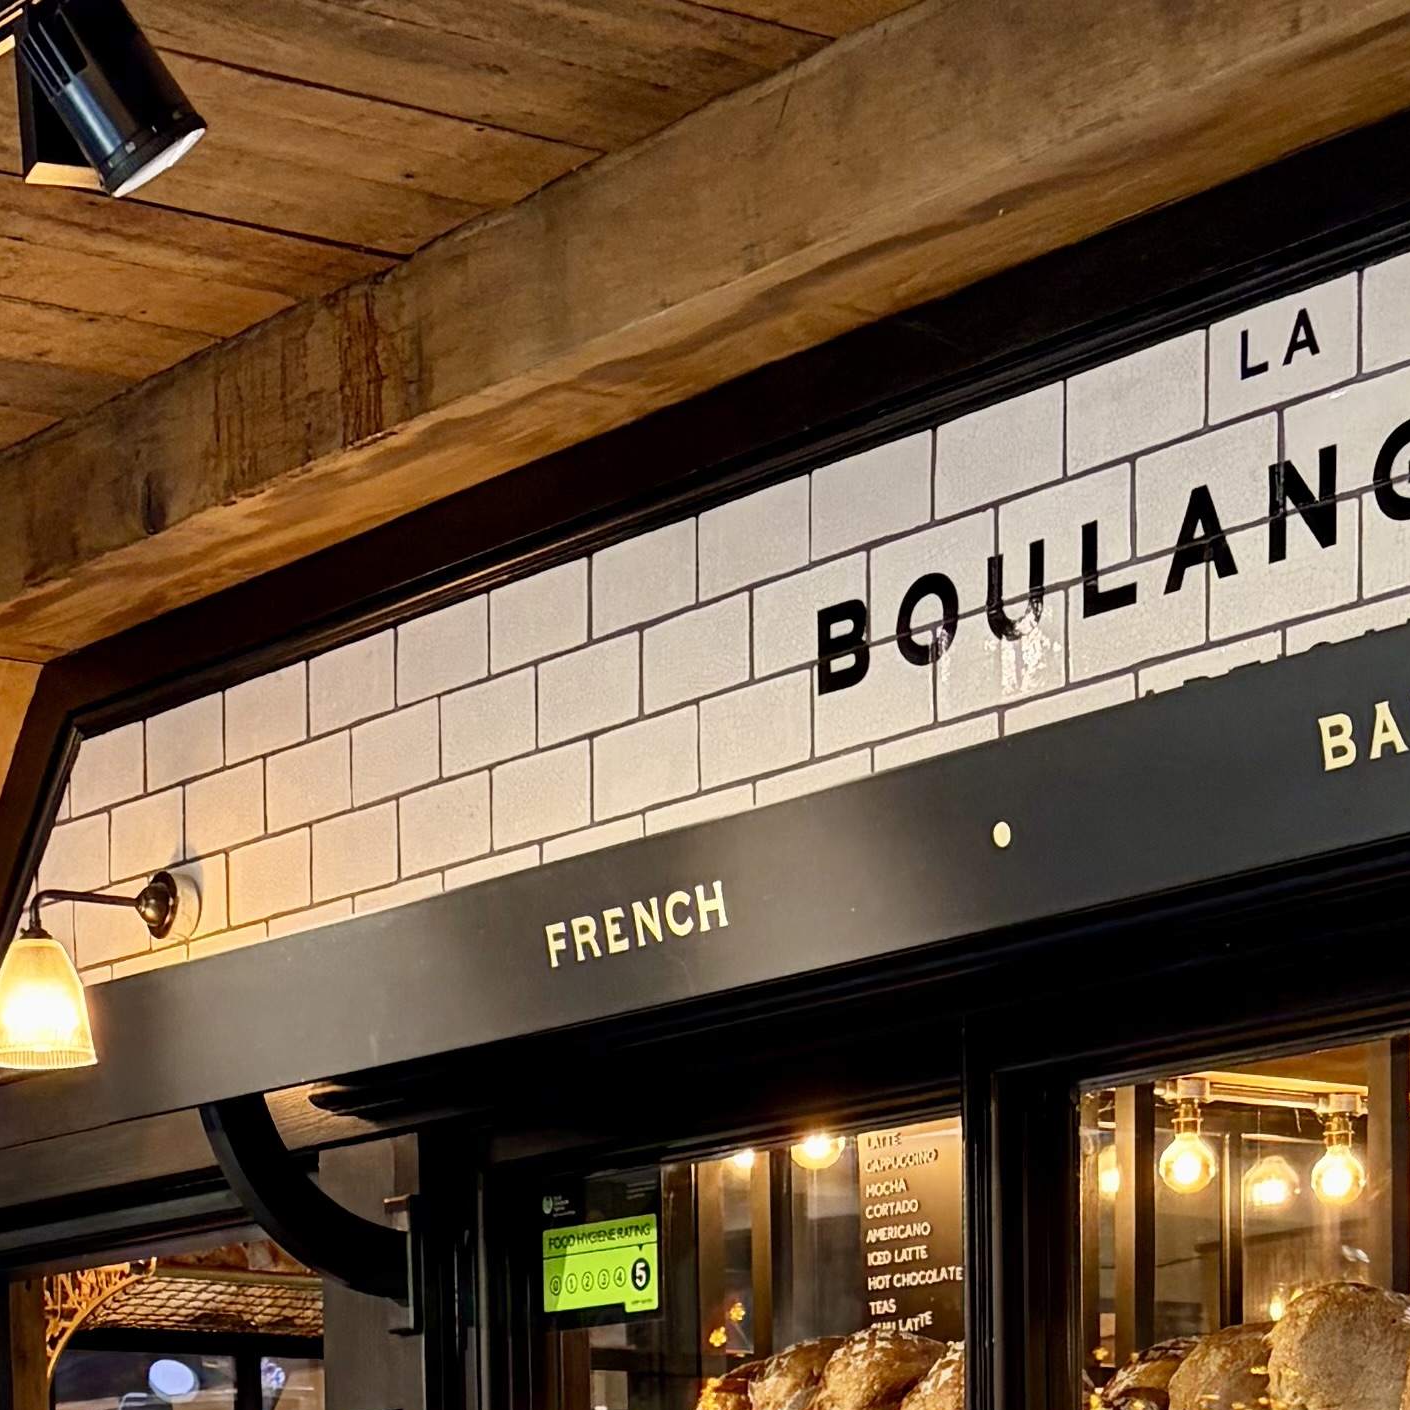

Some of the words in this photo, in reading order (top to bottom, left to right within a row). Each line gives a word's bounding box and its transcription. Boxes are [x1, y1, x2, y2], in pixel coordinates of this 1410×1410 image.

[1240, 308, 1320, 381] LA
[545, 879, 729, 968] FRENCH
[865, 1178, 909, 1198] MOCHA
[865, 1199, 919, 1219] CORTADO
[548, 1234, 576, 1250] FOOD
[866, 1222, 931, 1244] AMERICANO
[867, 1250, 892, 1267] ICED
[894, 1245, 929, 1263] LATTE
[635, 1261, 647, 1288] 5
[868, 1274, 892, 1291] HOT
[893, 1265, 964, 1289] CHOCOLATE
[869, 1299, 897, 1316] TEAS
[898, 1311, 933, 1332] LATTE
